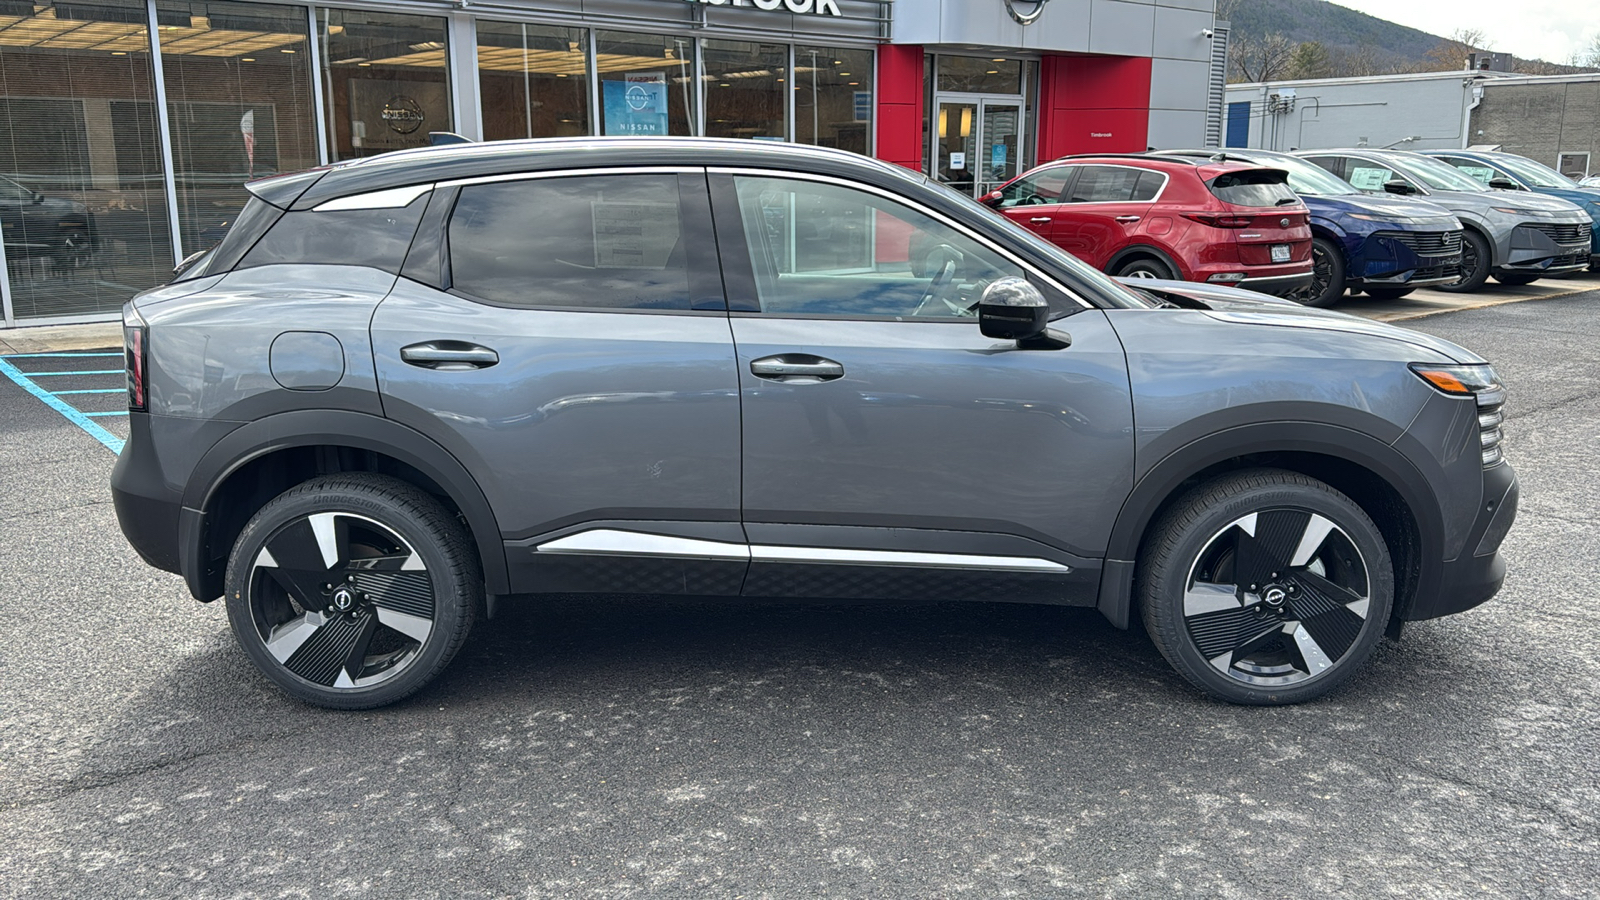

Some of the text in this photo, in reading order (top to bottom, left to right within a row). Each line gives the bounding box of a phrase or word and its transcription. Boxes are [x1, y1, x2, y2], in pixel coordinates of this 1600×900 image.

[620, 123, 655, 131] NISSAN
[313, 495, 387, 513] BRIDGESTONE
[1224, 491, 1298, 513] BRIDGESTONE
